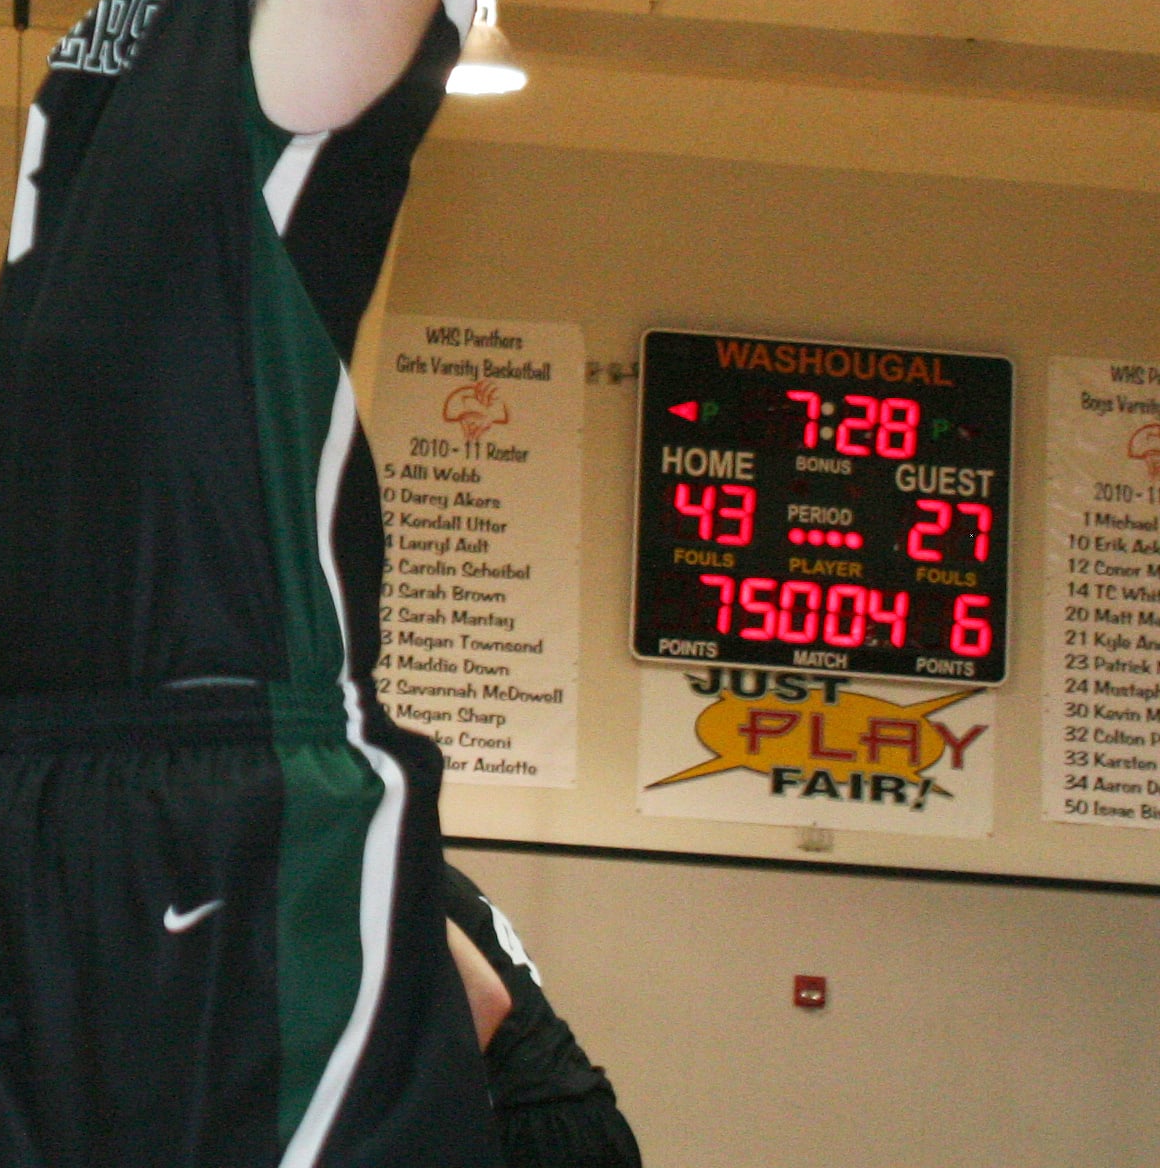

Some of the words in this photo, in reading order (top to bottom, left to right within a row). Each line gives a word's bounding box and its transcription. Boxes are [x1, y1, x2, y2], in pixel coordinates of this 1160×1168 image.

[426, 326, 460, 347] WHS
[464, 328, 523, 350] Panthers
[396, 353, 427, 374] Girls
[431, 356, 479, 380] Varsity
[483, 358, 552, 381] Basketball
[715, 339, 955, 386] WASHOUGAL
[1081, 391, 1114, 416] Boys
[786, 389, 921, 460] 7:28
[410, 437, 449, 458] 2010
[465, 440, 481, 460] 11
[487, 442, 529, 463] Roster
[661, 446, 757, 480] HOME
[795, 455, 853, 475] BONUS
[895, 463, 995, 498] GUEST
[1095, 482, 1133, 503] 2010
[399, 512, 461, 531] Kendall
[673, 483, 757, 547] 43
[788, 504, 853, 527] PERIOD
[907, 499, 992, 563] 27
[1069, 533, 1089, 551] 10
[1094, 536, 1128, 553] Erik
[673, 548, 736, 568] FOULS
[790, 558, 863, 579] PLAYER
[1068, 557, 1089, 574] 12
[915, 567, 977, 587] FOULS
[398, 583, 446, 601] Sarah
[451, 585, 506, 603] Brown
[1068, 581, 1089, 599] 14
[1095, 584, 1118, 600] TC
[398, 607, 446, 624] Sarah
[950, 593, 992, 658] 6
[1064, 606, 1089, 622] 20
[1094, 608, 1133, 625] Matt
[398, 631, 453, 651] Megan
[460, 635, 544, 654] Townsend
[658, 638, 719, 659] POINTS
[1064, 629, 1087, 646] 21
[1094, 631, 1132, 653] Kyle
[397, 655, 457, 673] Maddie
[463, 659, 510, 676] Down
[793, 649, 848, 670] MATCH
[915, 657, 976, 678] POINTS
[1064, 653, 1089, 670] 23
[1094, 656, 1151, 675] Patrick
[396, 678, 477, 699] Savannah
[483, 684, 564, 704] McDowell
[683, 667, 848, 706] JUST
[1064, 678, 1089, 694] 24
[396, 703, 452, 724] Megan
[457, 707, 506, 729] Sharp
[1064, 702, 1089, 718] 30
[1094, 704, 1141, 721] Kevin
[738, 707, 989, 769] PLAY
[1064, 726, 1088, 743] 32
[1064, 750, 1089, 766] 33
[771, 767, 935, 810] FAIR!
[1064, 774, 1088, 791] 34
[1093, 777, 1143, 794] Aaron
[1064, 798, 1089, 815] 50
